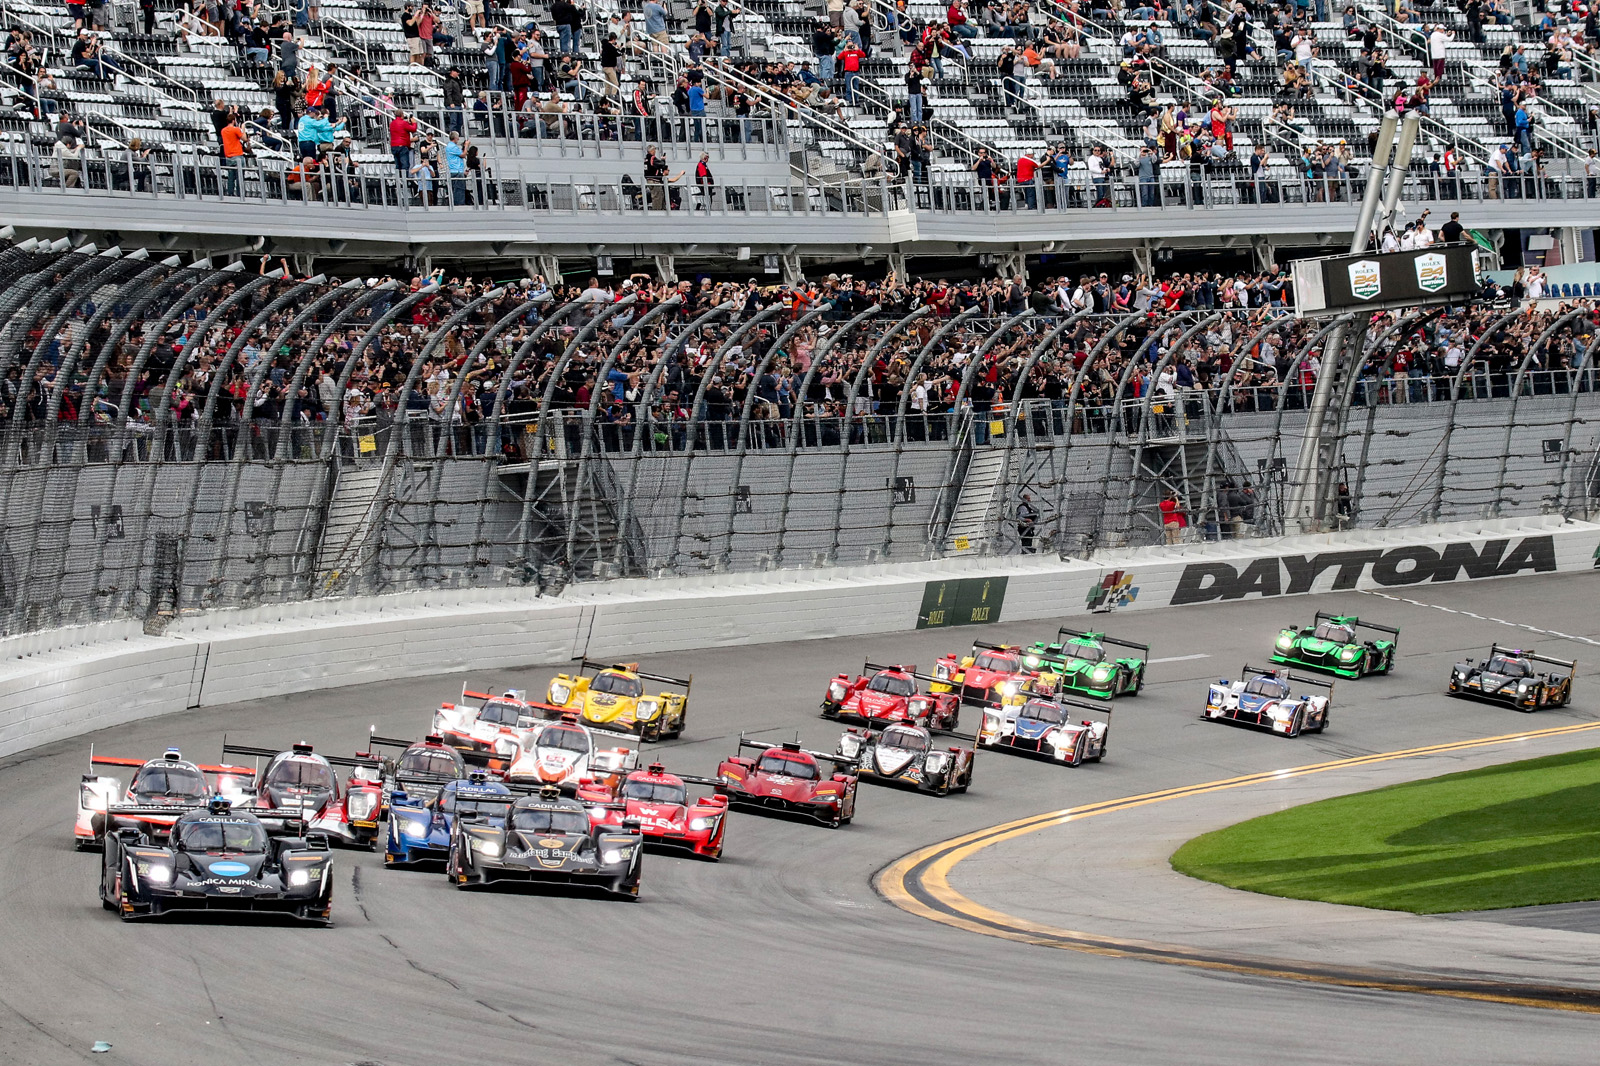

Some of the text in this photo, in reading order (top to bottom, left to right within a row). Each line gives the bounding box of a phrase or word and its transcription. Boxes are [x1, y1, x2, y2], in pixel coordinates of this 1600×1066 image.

[1420, 266, 1444, 278] 24
[1354, 274, 1377, 285] 24
[1169, 535, 1557, 605] DAYTONA
[927, 610, 945, 625] ROLEX
[970, 607, 991, 622] ROLEX
[144, 762, 197, 772] ACURA
[615, 814, 682, 831] WHELEN
[186, 878, 273, 890] KONICA MINOLTA
